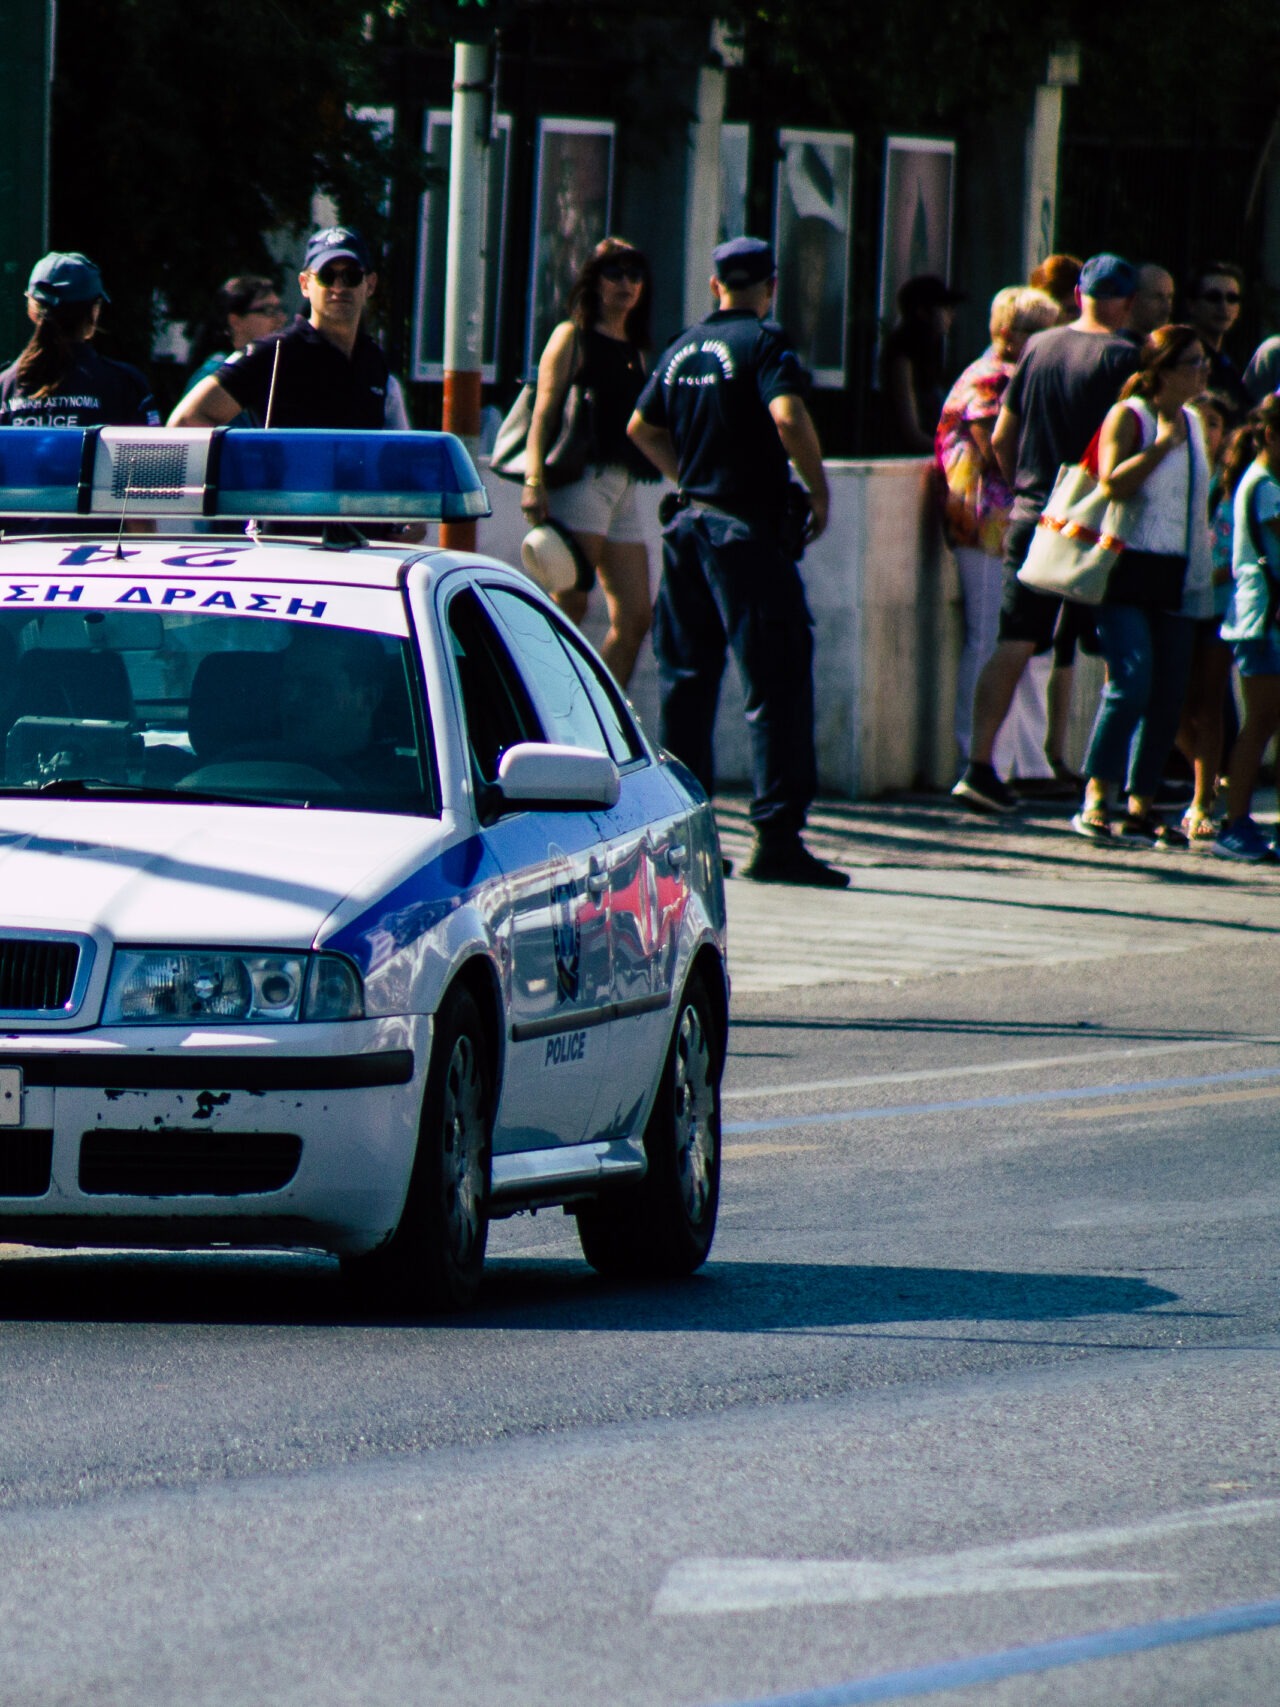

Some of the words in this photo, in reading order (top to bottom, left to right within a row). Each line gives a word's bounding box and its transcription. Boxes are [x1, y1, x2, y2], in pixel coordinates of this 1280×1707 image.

[13, 415, 79, 428] POLICE
[114, 586, 328, 618] ΔΡΑΣΗ
[545, 1031, 586, 1066] POLICE
